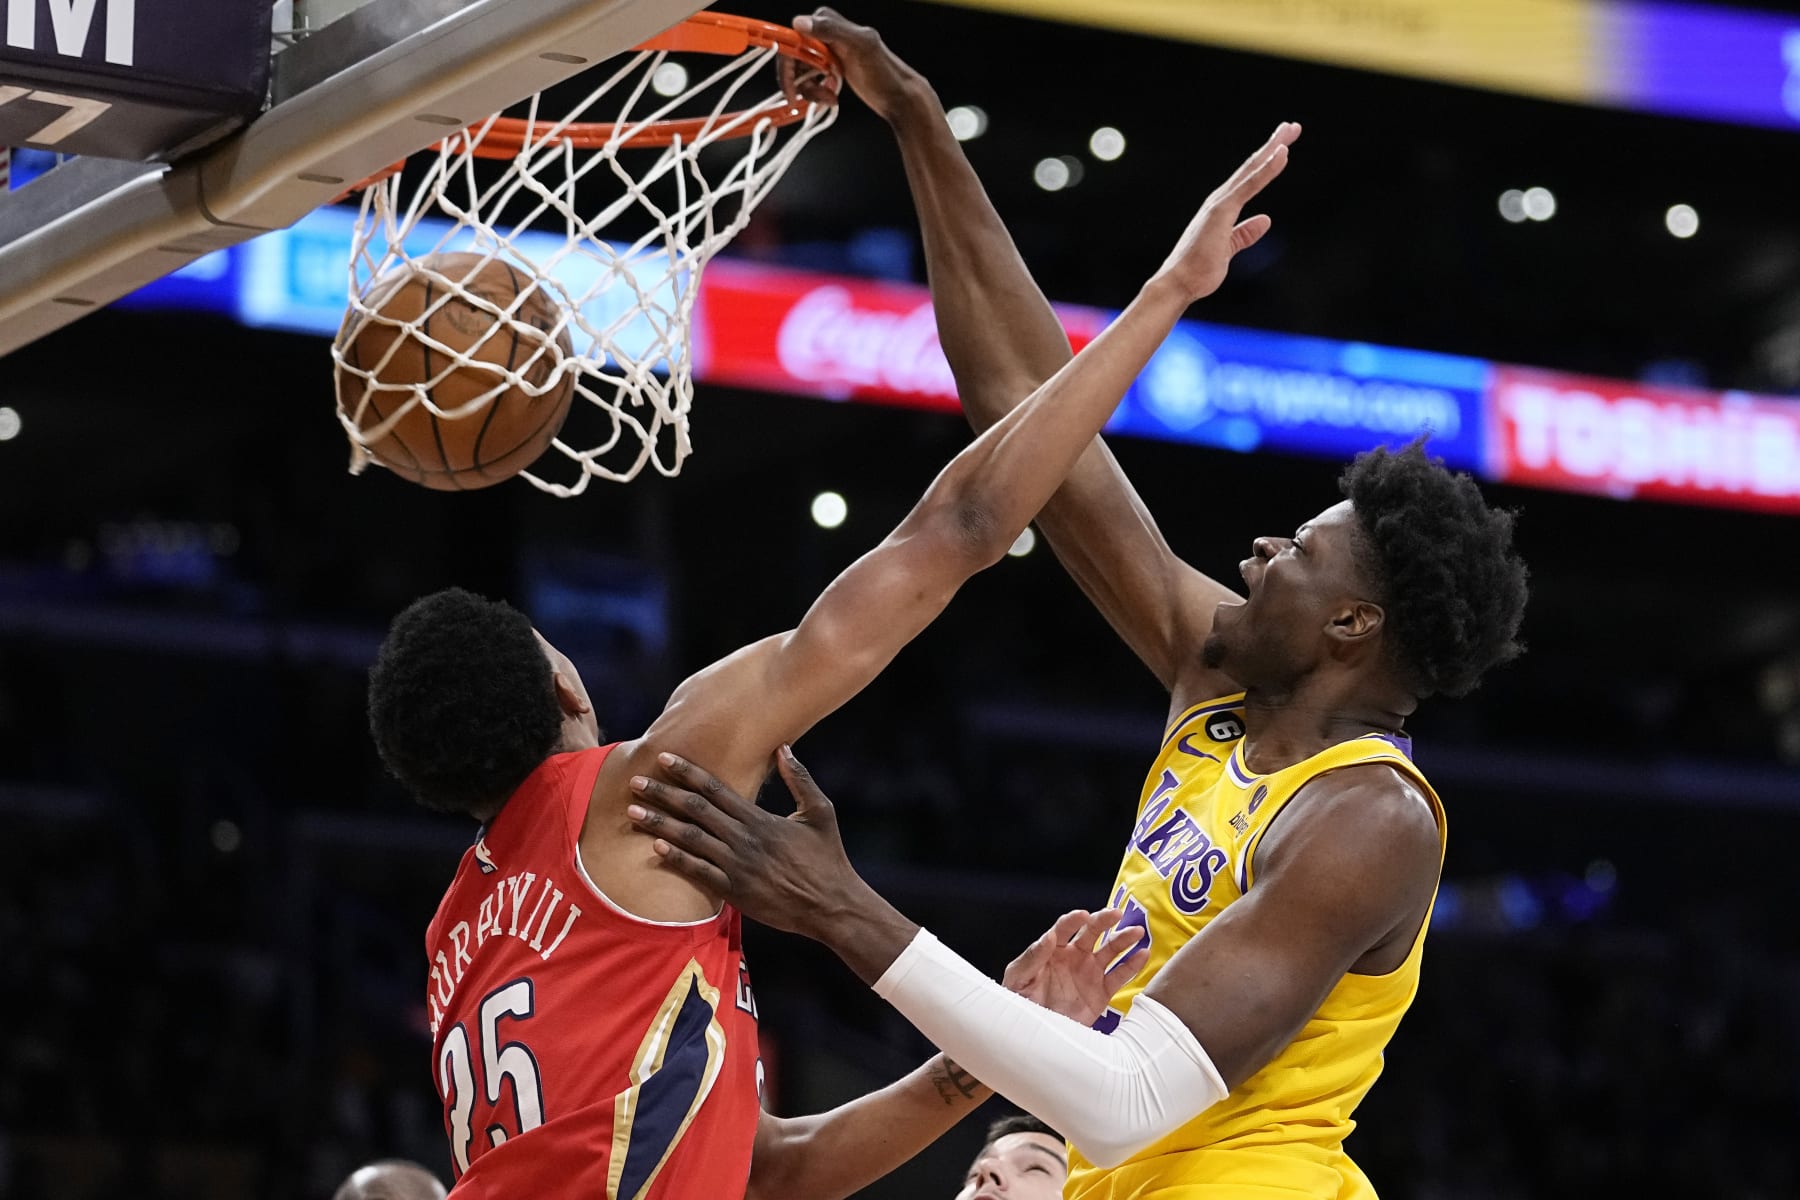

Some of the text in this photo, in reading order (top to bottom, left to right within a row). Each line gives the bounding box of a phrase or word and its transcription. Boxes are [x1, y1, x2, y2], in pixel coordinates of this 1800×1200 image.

[1209, 719, 1242, 740] 6
[1126, 767, 1228, 915] LAKERS
[439, 976, 546, 1176] 25
